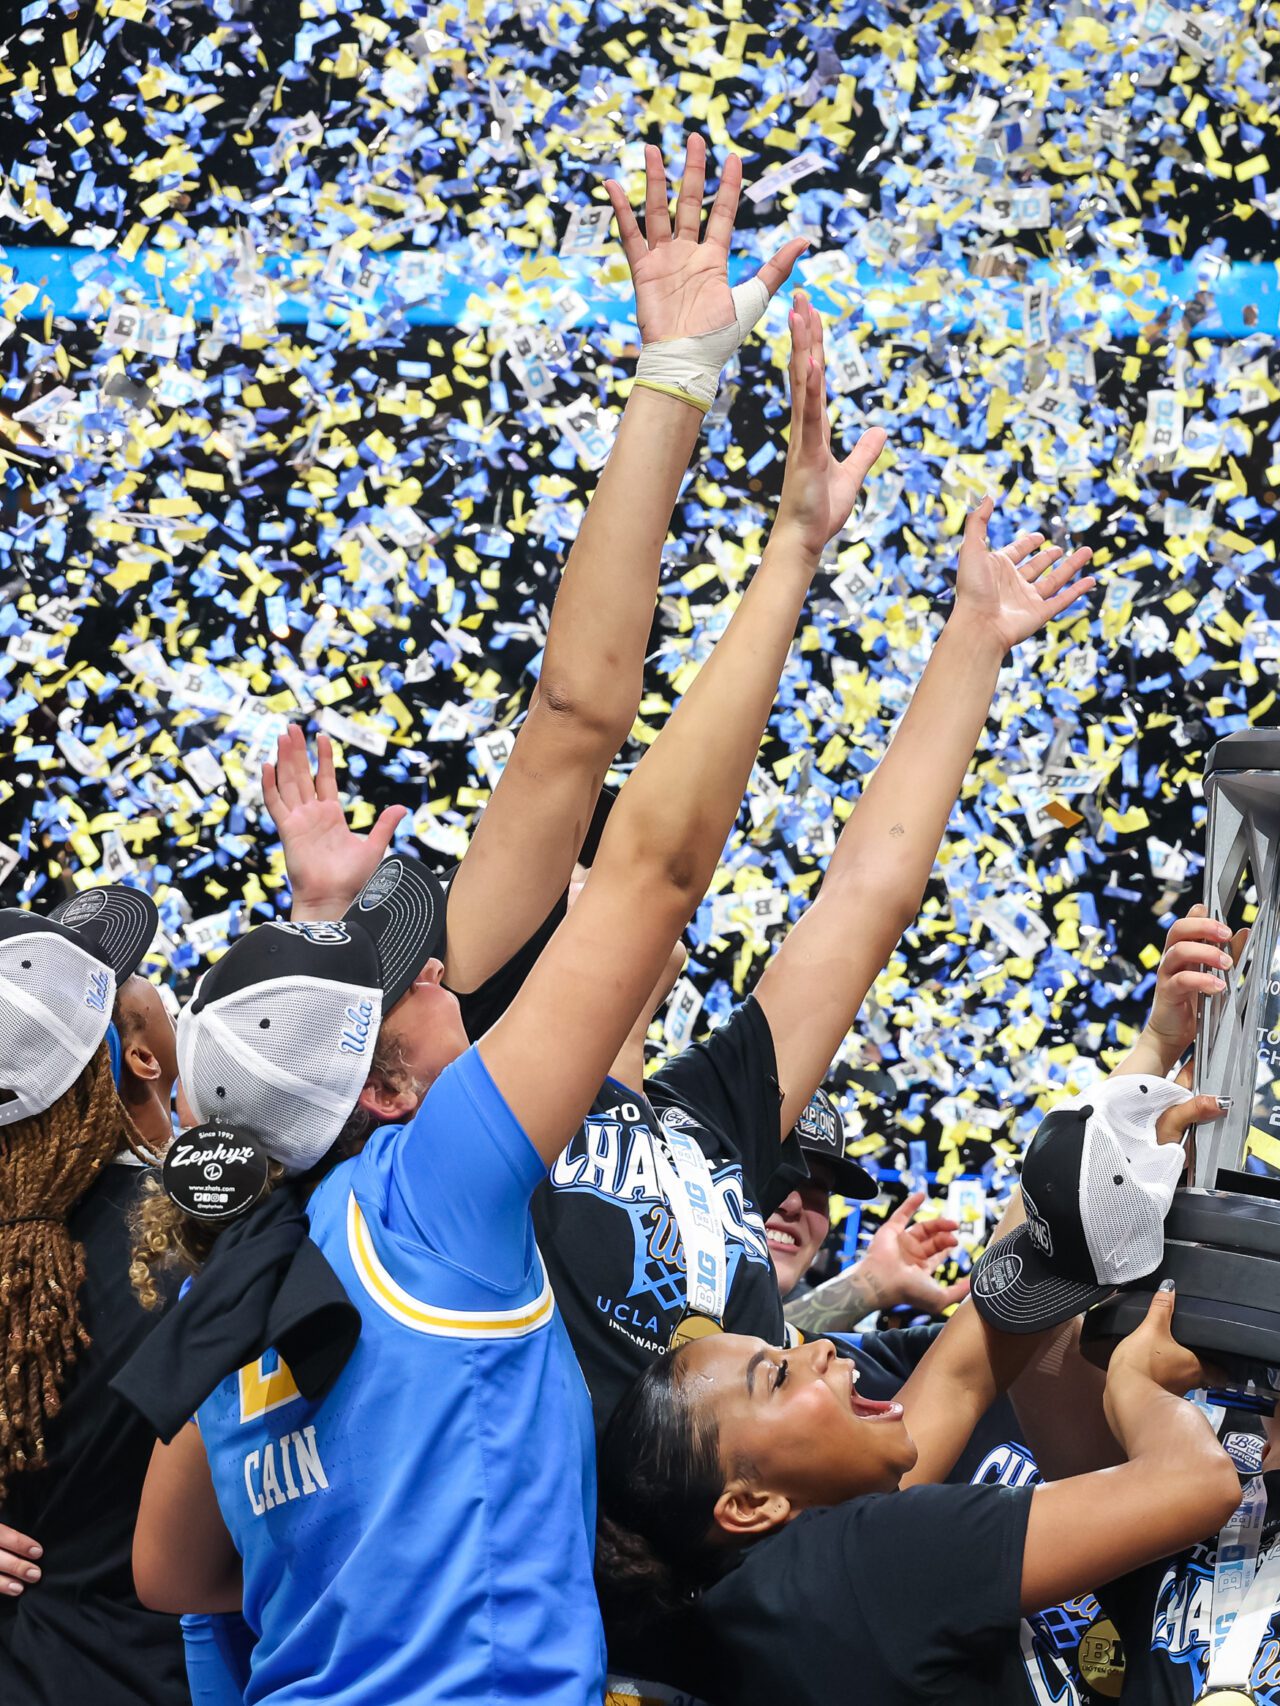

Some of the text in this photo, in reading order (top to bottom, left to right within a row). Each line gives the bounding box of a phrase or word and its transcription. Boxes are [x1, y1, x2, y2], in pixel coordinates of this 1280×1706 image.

[86, 970, 109, 1012] Ucla
[340, 999, 373, 1055] Ucla
[170, 1143, 255, 1167] Zephyr
[597, 1295, 659, 1334] UCLA
[244, 1425, 330, 1516] CAIN
